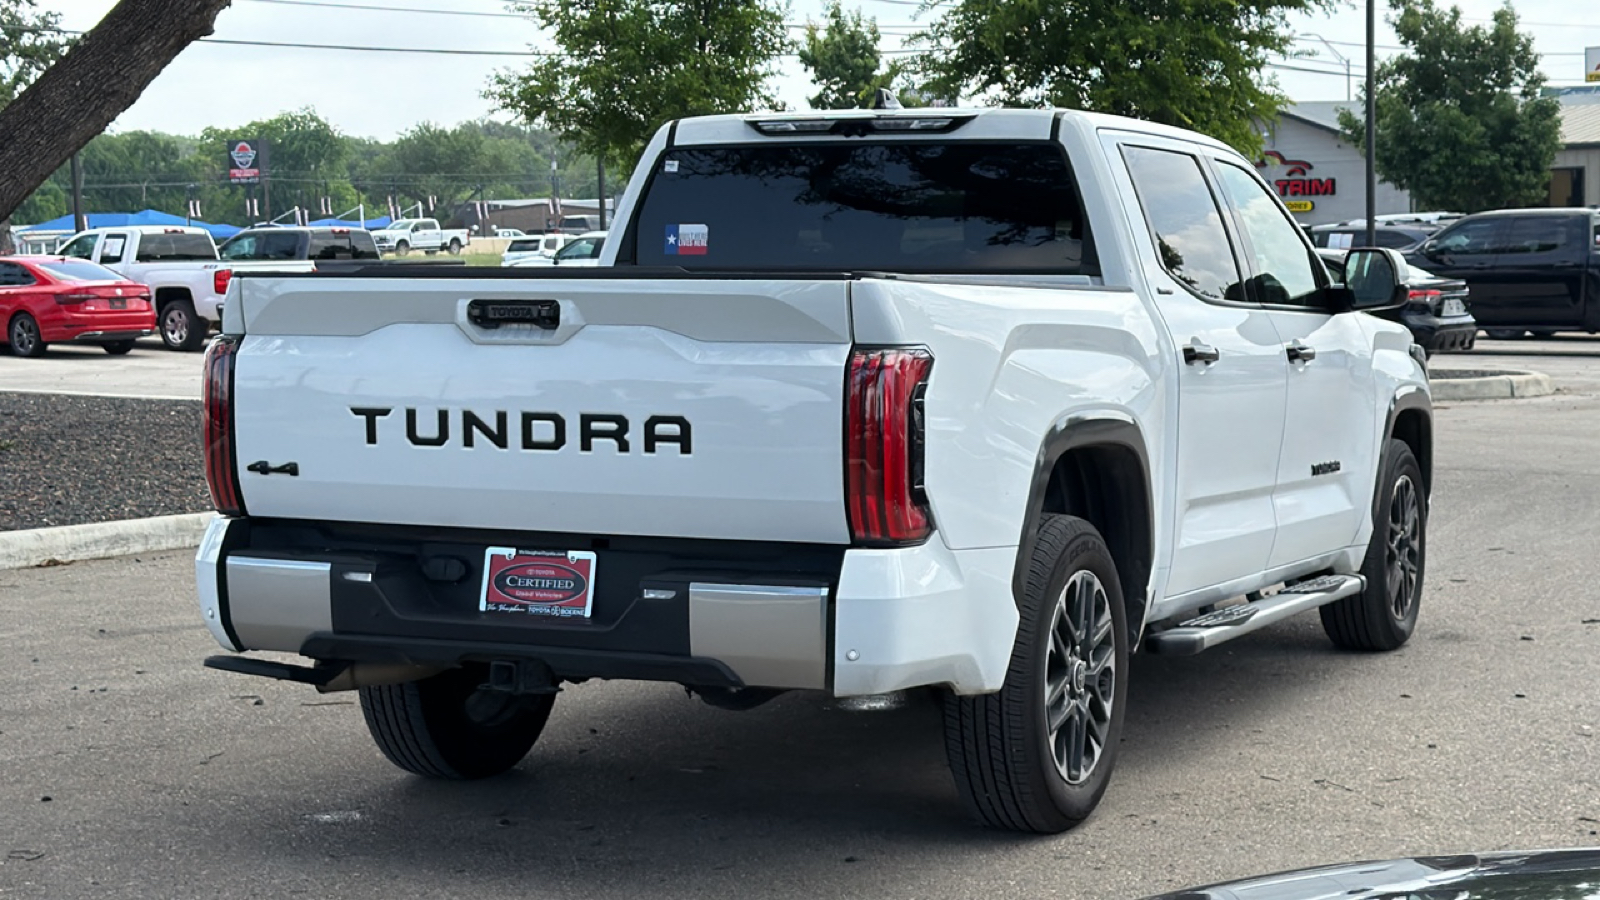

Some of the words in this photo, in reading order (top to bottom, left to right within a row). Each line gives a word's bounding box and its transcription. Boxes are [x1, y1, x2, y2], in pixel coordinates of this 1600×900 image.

[1275, 178, 1335, 195] TRIM
[490, 306, 534, 317] TOYOTA
[349, 406, 692, 455] TUNDRA
[515, 590, 534, 598] Used
